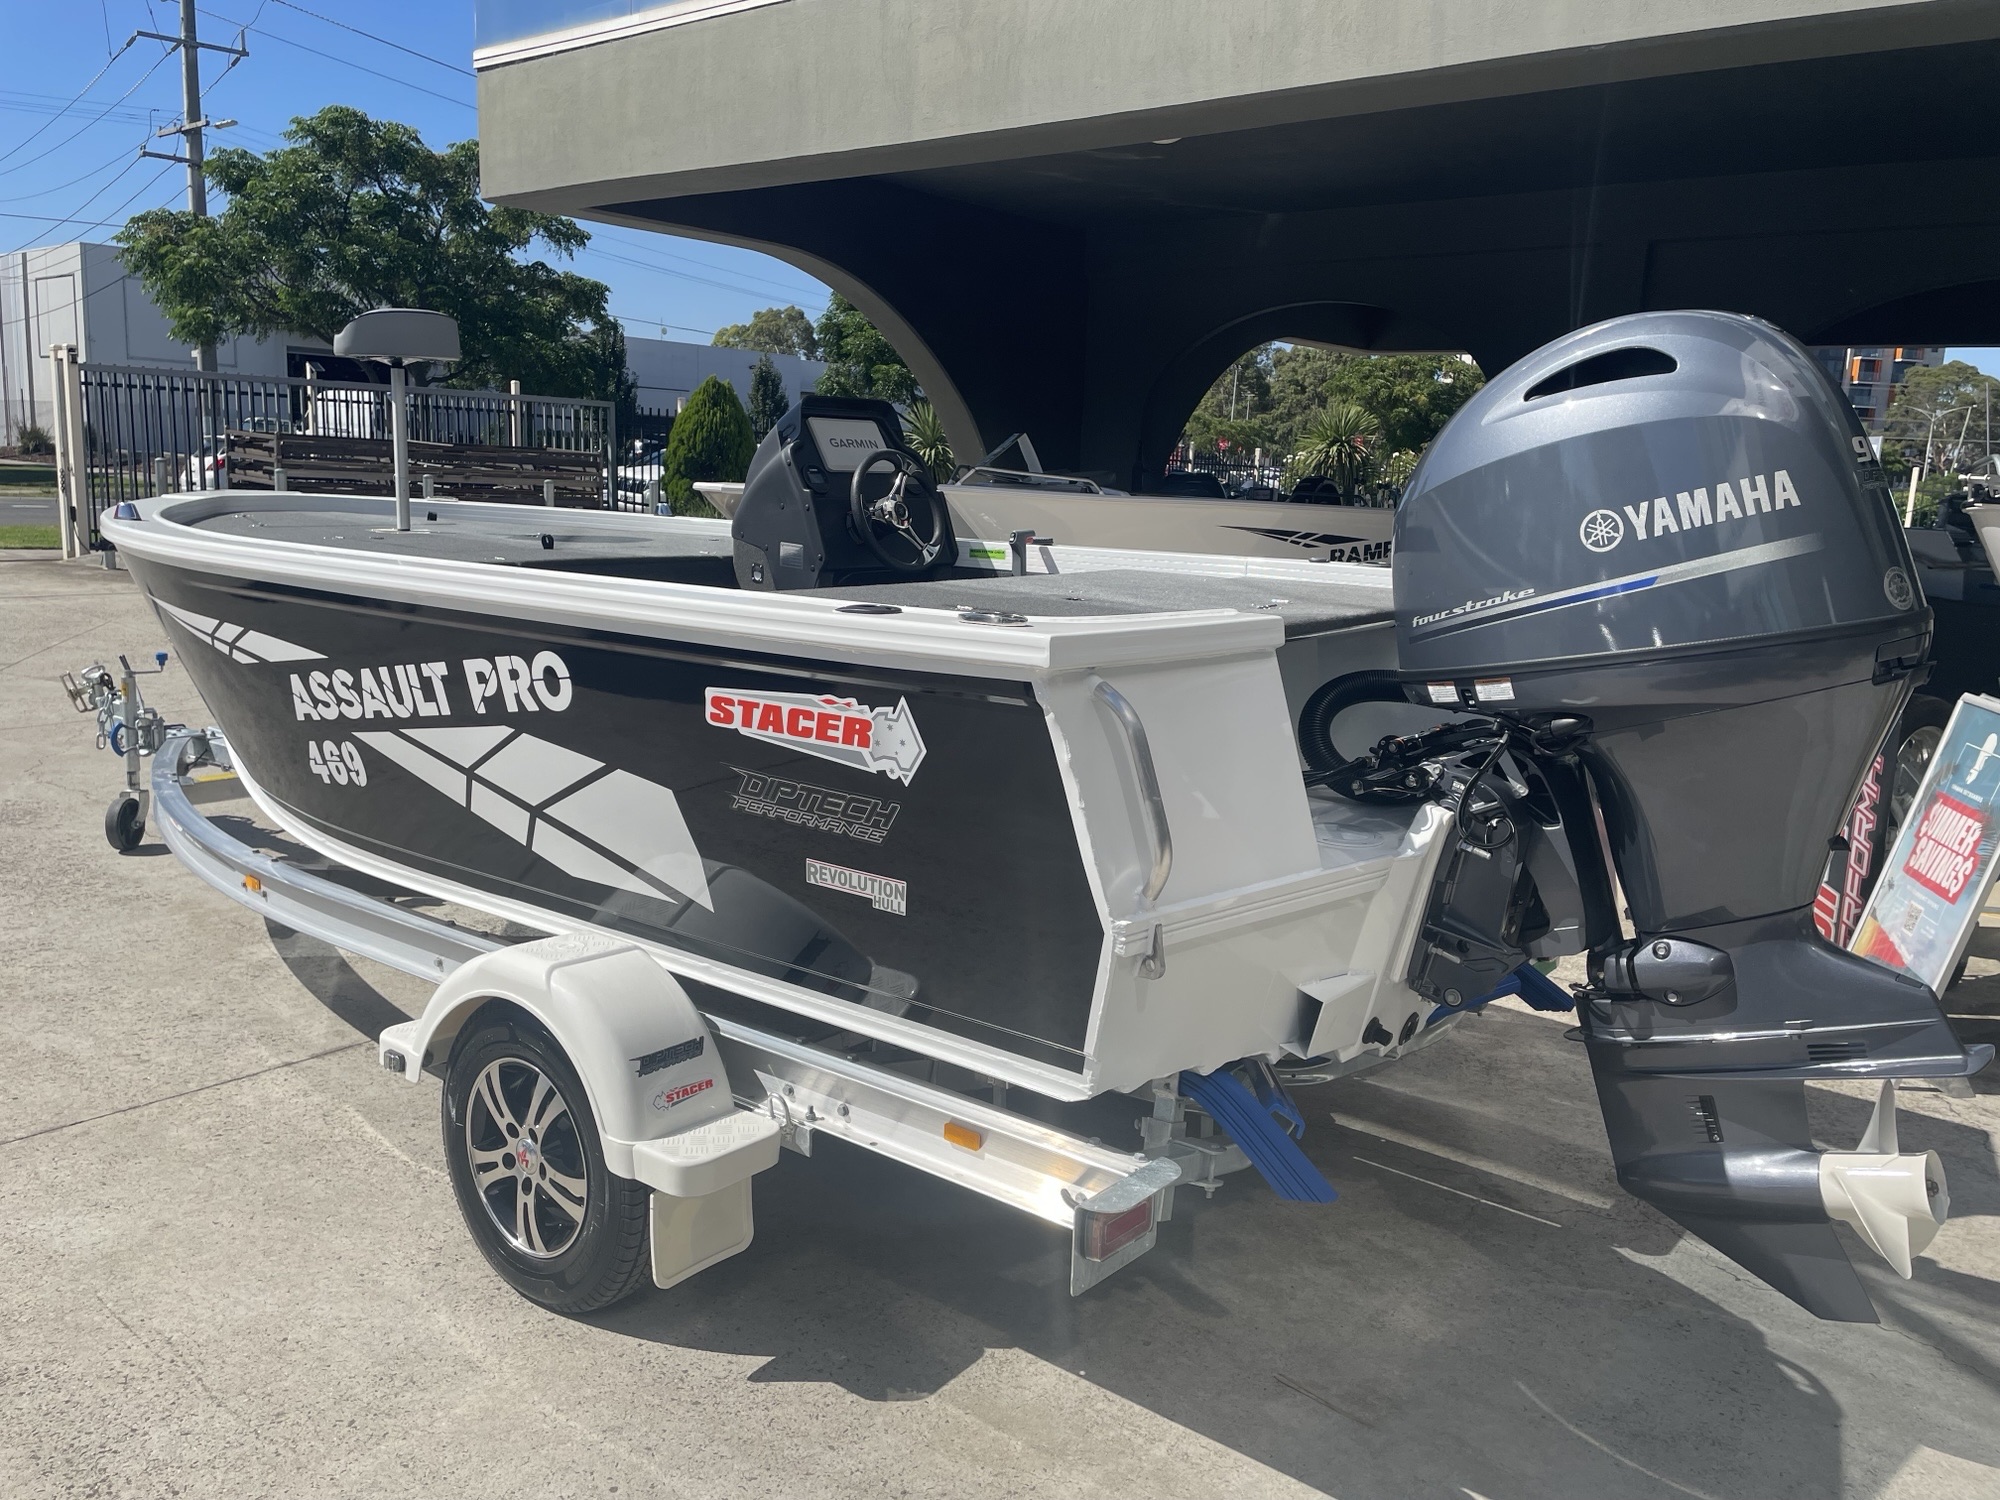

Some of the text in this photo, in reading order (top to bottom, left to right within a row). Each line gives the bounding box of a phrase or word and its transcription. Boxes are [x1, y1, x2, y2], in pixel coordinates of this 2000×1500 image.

[829, 437, 879, 449] GARMIN
[1623, 469, 1801, 541] YAMAHA
[289, 650, 573, 721] ASSAULT PRO
[709, 695, 873, 750] STACER
[308, 739, 367, 788] 469
[729, 766, 901, 830] DIPTECH
[730, 795, 889, 844] PERFORMANCE
[807, 862, 905, 901] REVOLUTION
[873, 895, 905, 914] HULL
[666, 1079, 714, 1104] STACER
